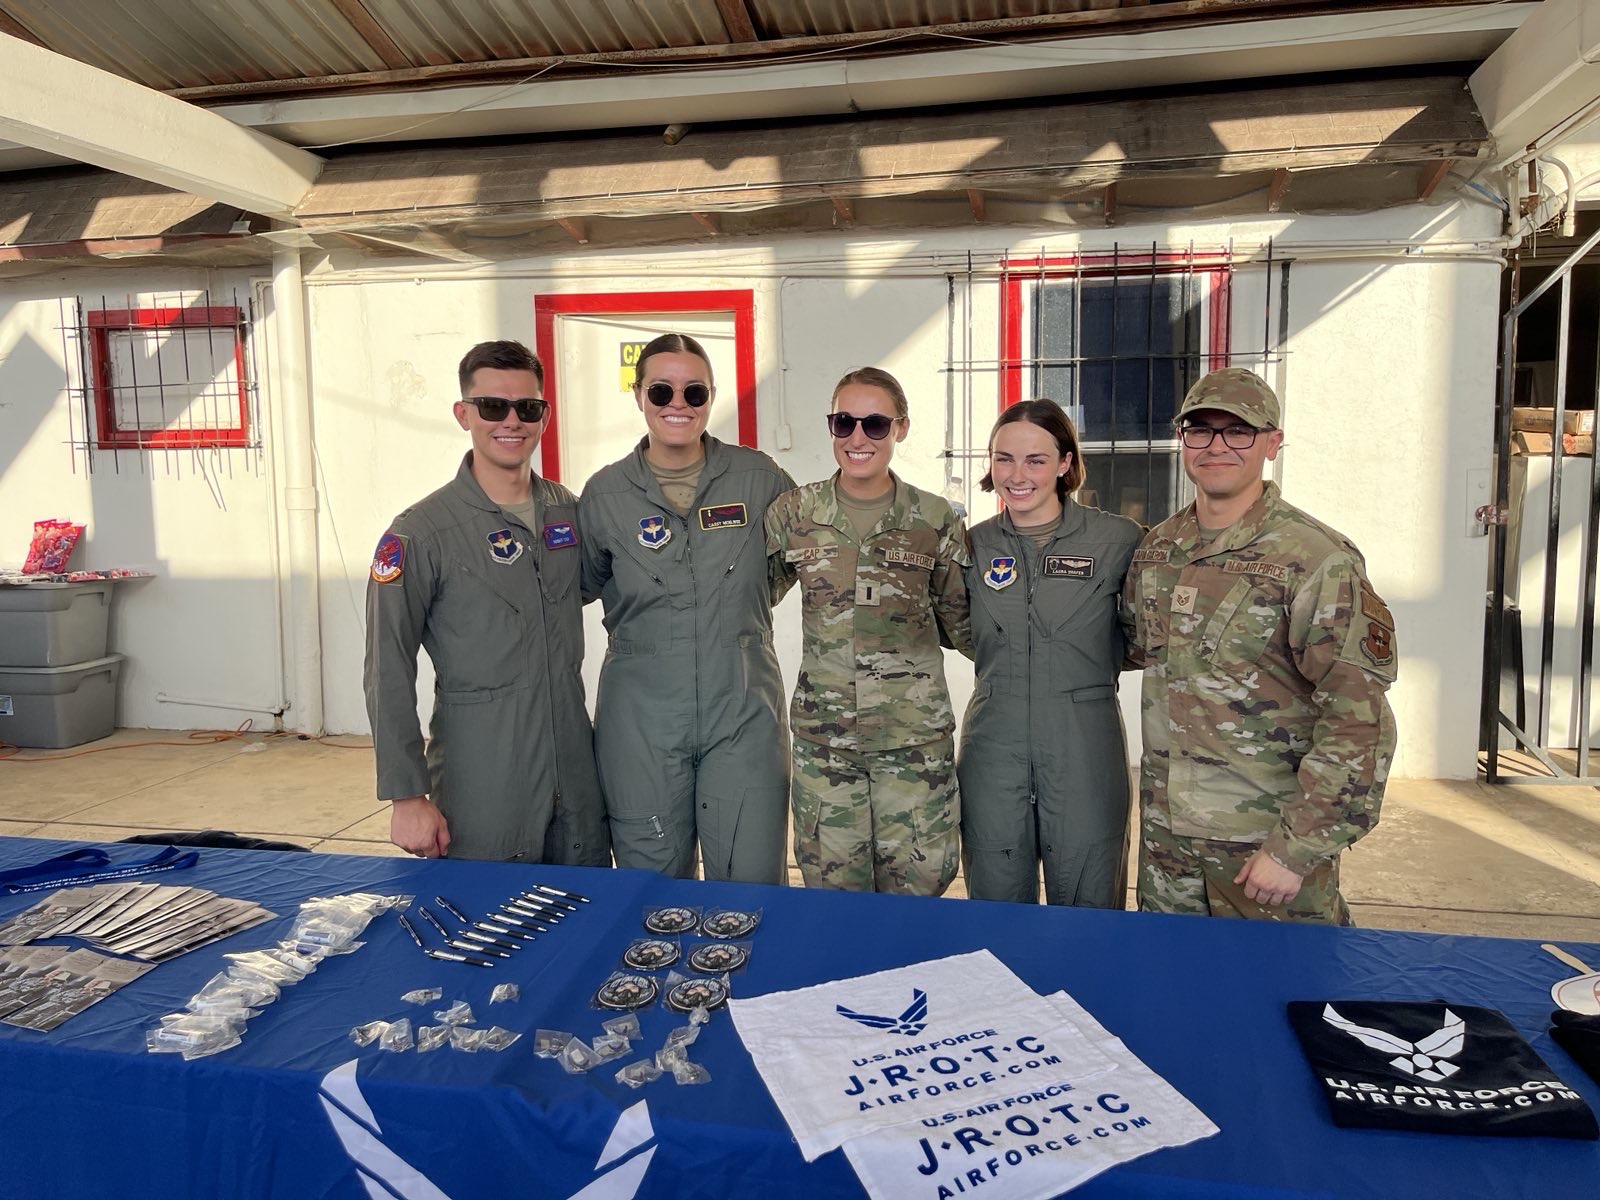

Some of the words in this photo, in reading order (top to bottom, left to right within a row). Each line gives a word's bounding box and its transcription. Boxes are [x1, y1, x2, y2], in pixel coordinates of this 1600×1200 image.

[903, 552, 915, 564] AIR
[916, 555, 934, 569] FORCE
[1243, 562, 1258, 573] AIR
[1257, 563, 1286, 579] FORCE
[852, 1053, 892, 1067] U.S.
[895, 1044, 928, 1057] AIR
[929, 1029, 998, 1051] FORCE
[859, 1055, 1062, 1112] AIRFORCE.COM
[1325, 1077, 1389, 1093] U.S.
[1394, 1085, 1451, 1098] AIR
[1453, 1081, 1569, 1100] FORCE
[921, 1112, 964, 1128] U.S.
[966, 1103, 1002, 1118] AIR
[1003, 1084, 1076, 1107] FORCE
[1335, 1090, 1581, 1111] AIRFORCE.COM
[937, 1116, 1151, 1200] AIRFORCE.COM
